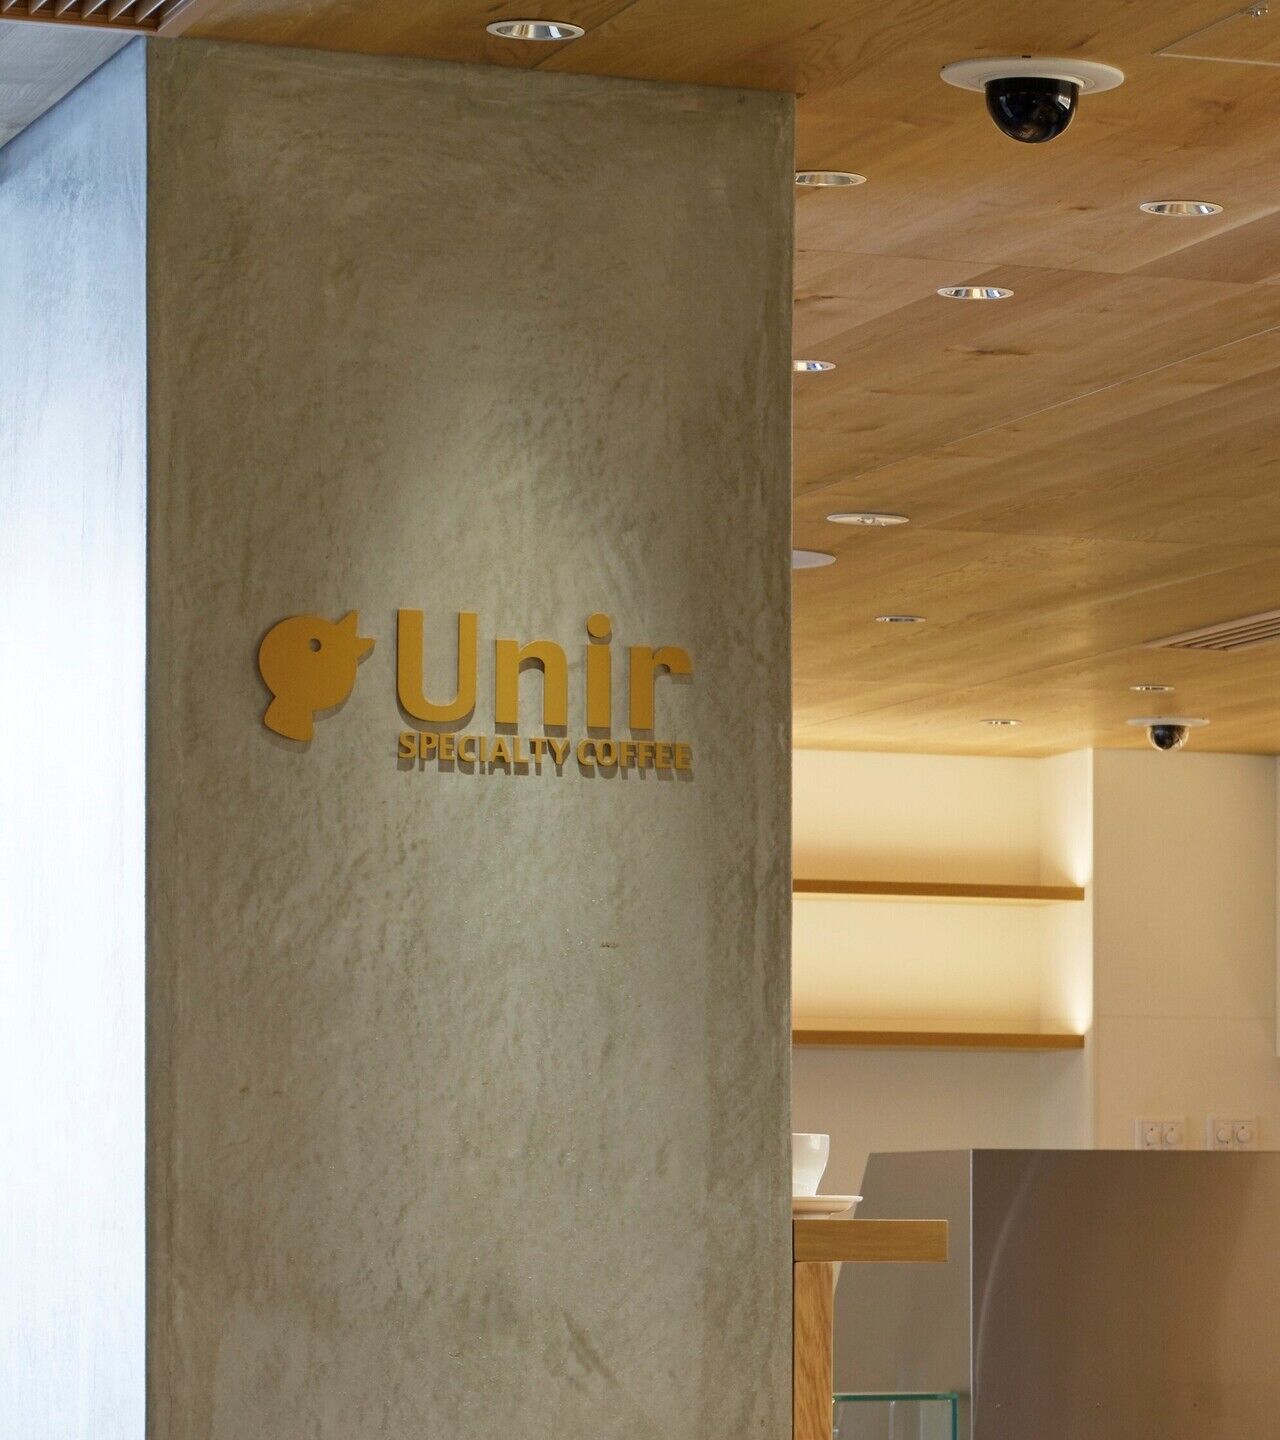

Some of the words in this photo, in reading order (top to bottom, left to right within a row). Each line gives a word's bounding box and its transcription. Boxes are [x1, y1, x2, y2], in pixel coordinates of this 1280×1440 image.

[397, 609, 692, 729] Unir
[398, 732, 570, 765] SPECIALTY
[577, 738, 692, 769] COFFEE
